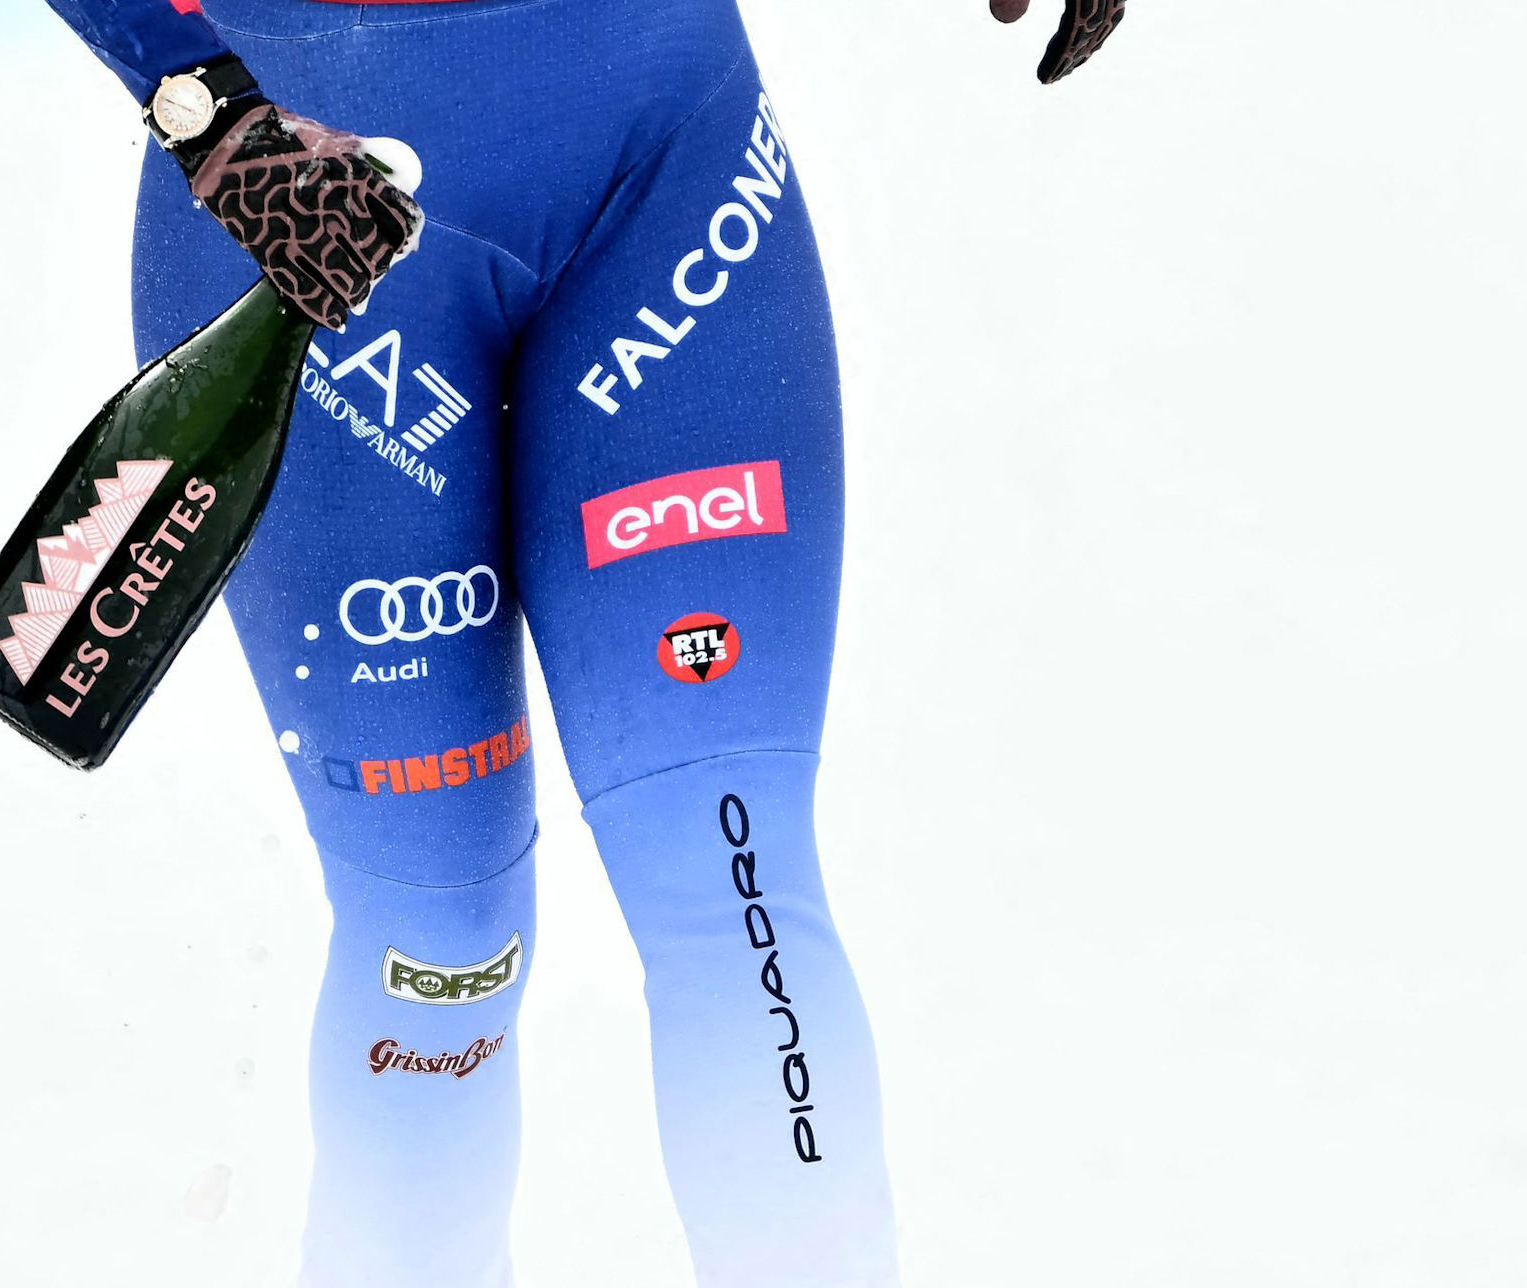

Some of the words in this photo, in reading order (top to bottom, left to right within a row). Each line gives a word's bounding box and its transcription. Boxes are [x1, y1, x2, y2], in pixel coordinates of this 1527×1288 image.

[576, 91, 787, 415] FALCONER
[305, 328, 473, 452] A7
[366, 429, 448, 497] ARMANI
[606, 471, 765, 550] enel
[350, 656, 429, 684] Audi
[671, 628, 726, 655] RTL
[674, 647, 728, 668] 102.5
[45, 640, 110, 718] LES
[389, 943, 520, 1001] FORST
[718, 793, 823, 1164] PIQUADRO
